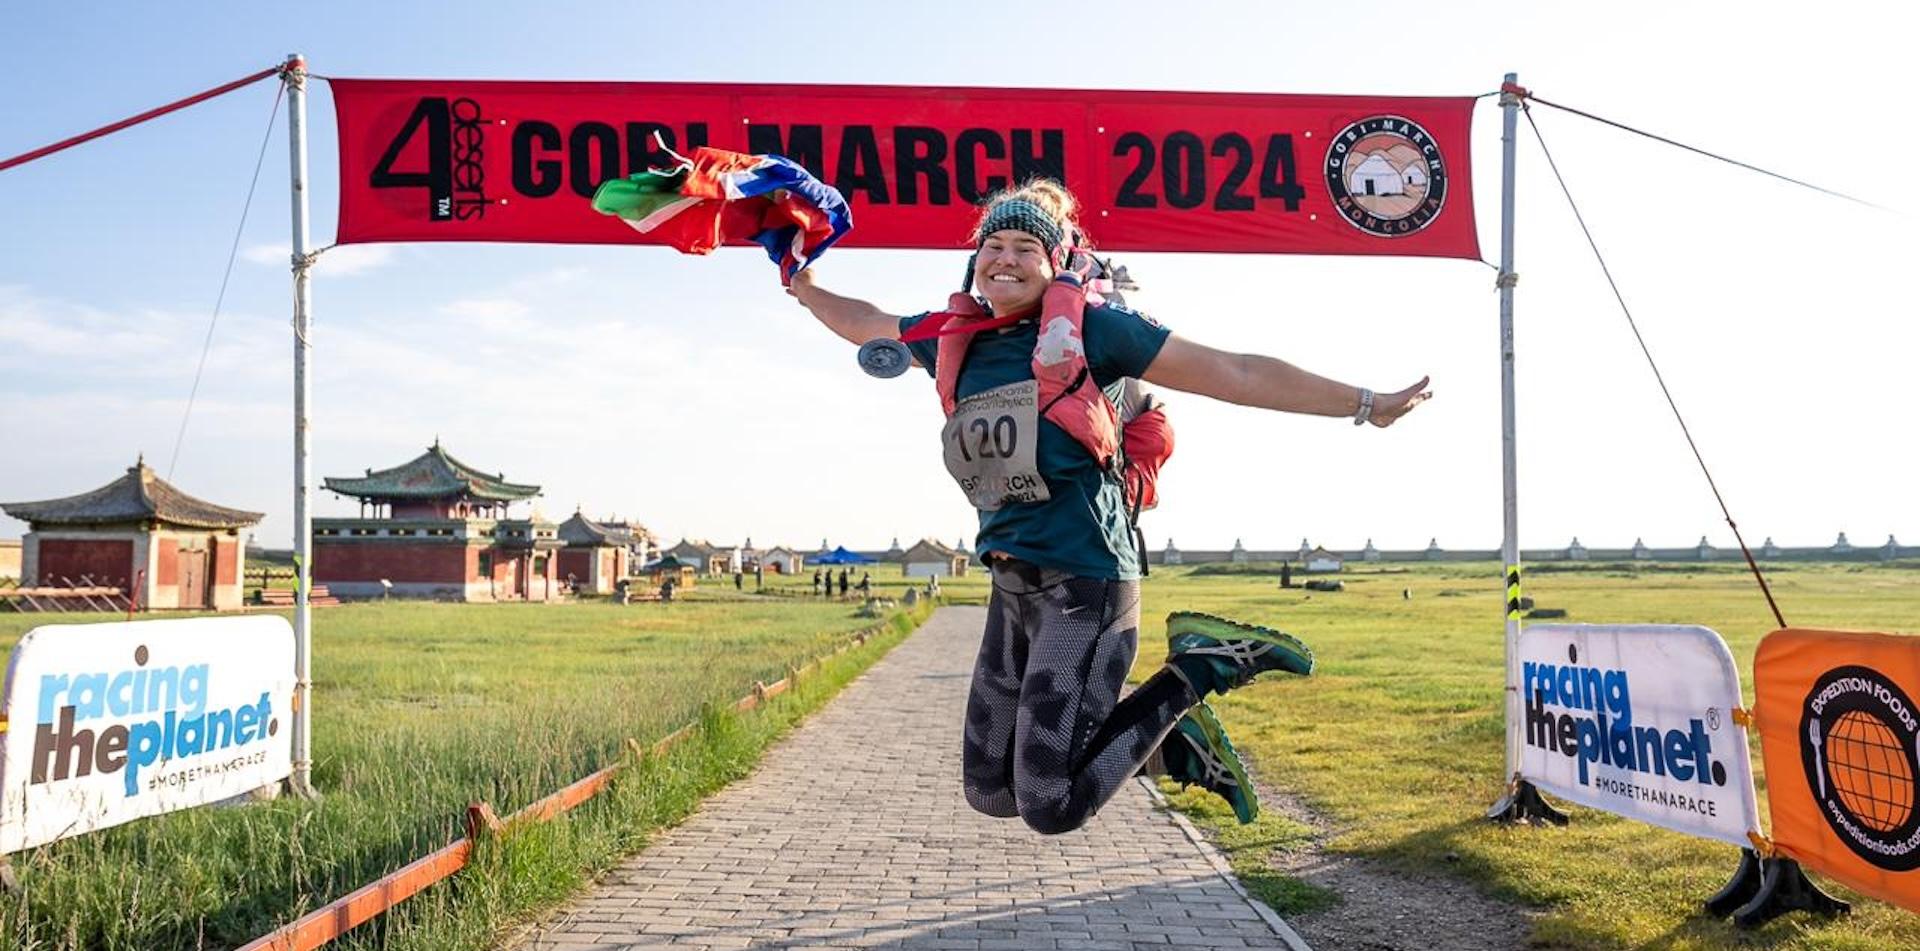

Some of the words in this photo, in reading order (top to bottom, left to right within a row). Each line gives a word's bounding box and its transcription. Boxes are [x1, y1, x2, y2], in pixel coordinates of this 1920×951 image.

[370, 97, 452, 221] 4
[452, 98, 494, 221] deserts
[1113, 131, 1304, 212] 2024
[1329, 125, 1367, 168] GOBI
[1382, 120, 1440, 170] MARCH
[438, 197, 450, 216] TM
[1340, 197, 1439, 231] MONGOLIA
[951, 414, 1017, 462] 120
[37, 645, 209, 722] racing
[1523, 643, 1632, 731] racing
[1811, 677, 1872, 716] EXPEDITION
[1874, 684, 1917, 733] FOODS
[1595, 778, 1717, 817] #MORETHANARACE
